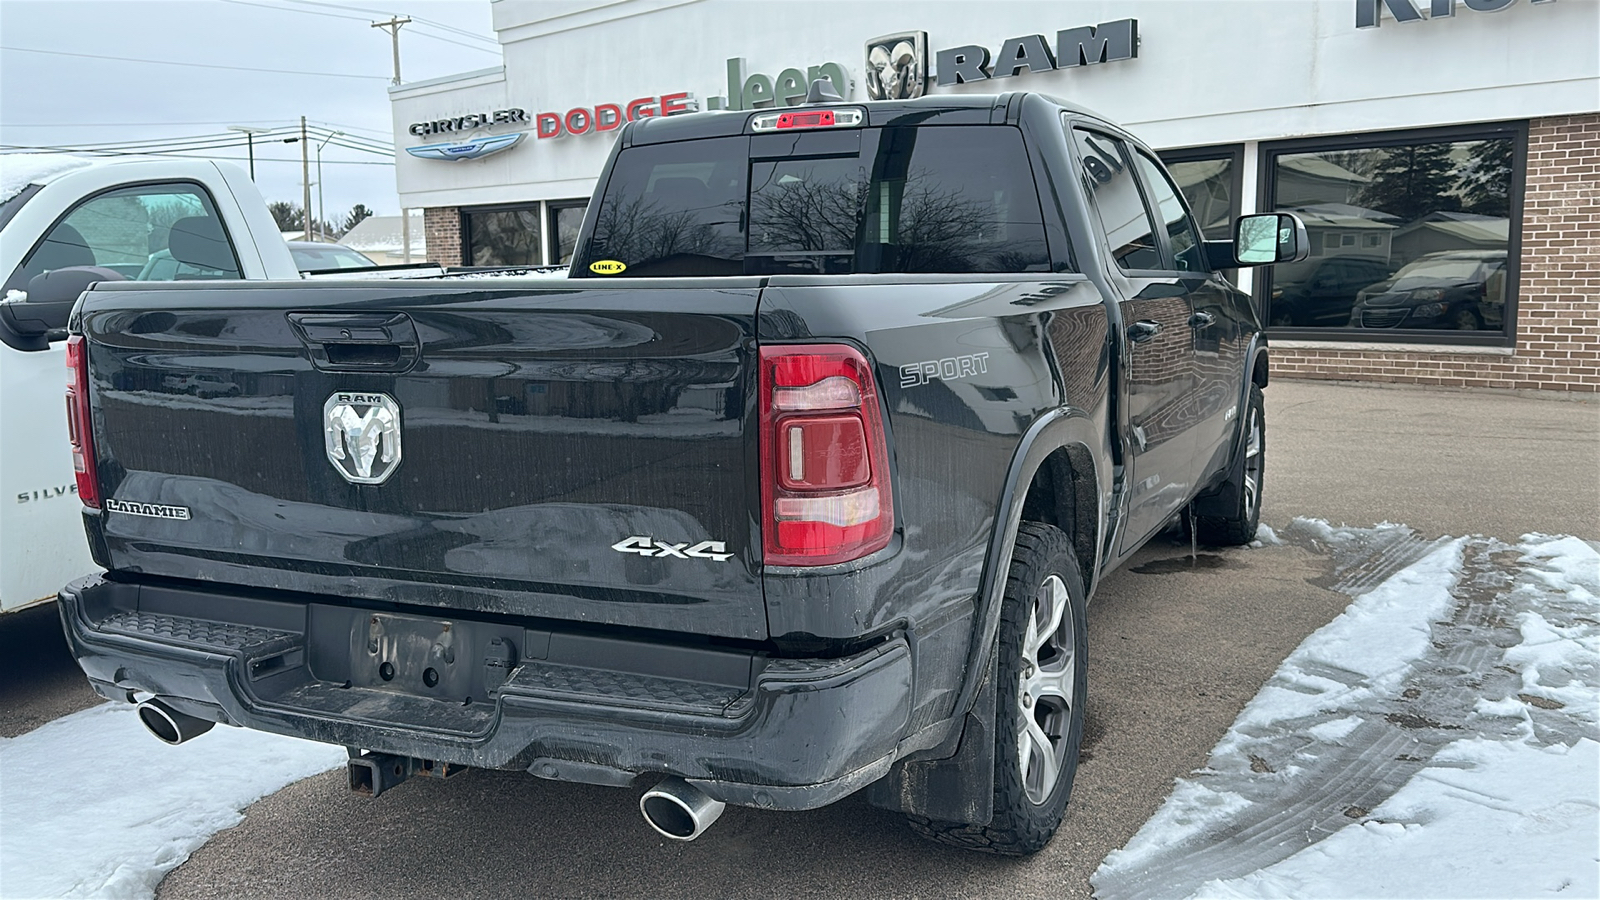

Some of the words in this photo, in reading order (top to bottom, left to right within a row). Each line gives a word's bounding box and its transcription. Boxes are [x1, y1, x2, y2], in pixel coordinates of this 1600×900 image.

[936, 18, 1138, 86] RAM
[707, 57, 850, 111] Jeep
[409, 108, 526, 136] CHRYSLER
[536, 92, 697, 139] DODGE
[900, 352, 989, 388] SPORT
[338, 394, 381, 403] RAM
[106, 499, 191, 521] LARAMIE
